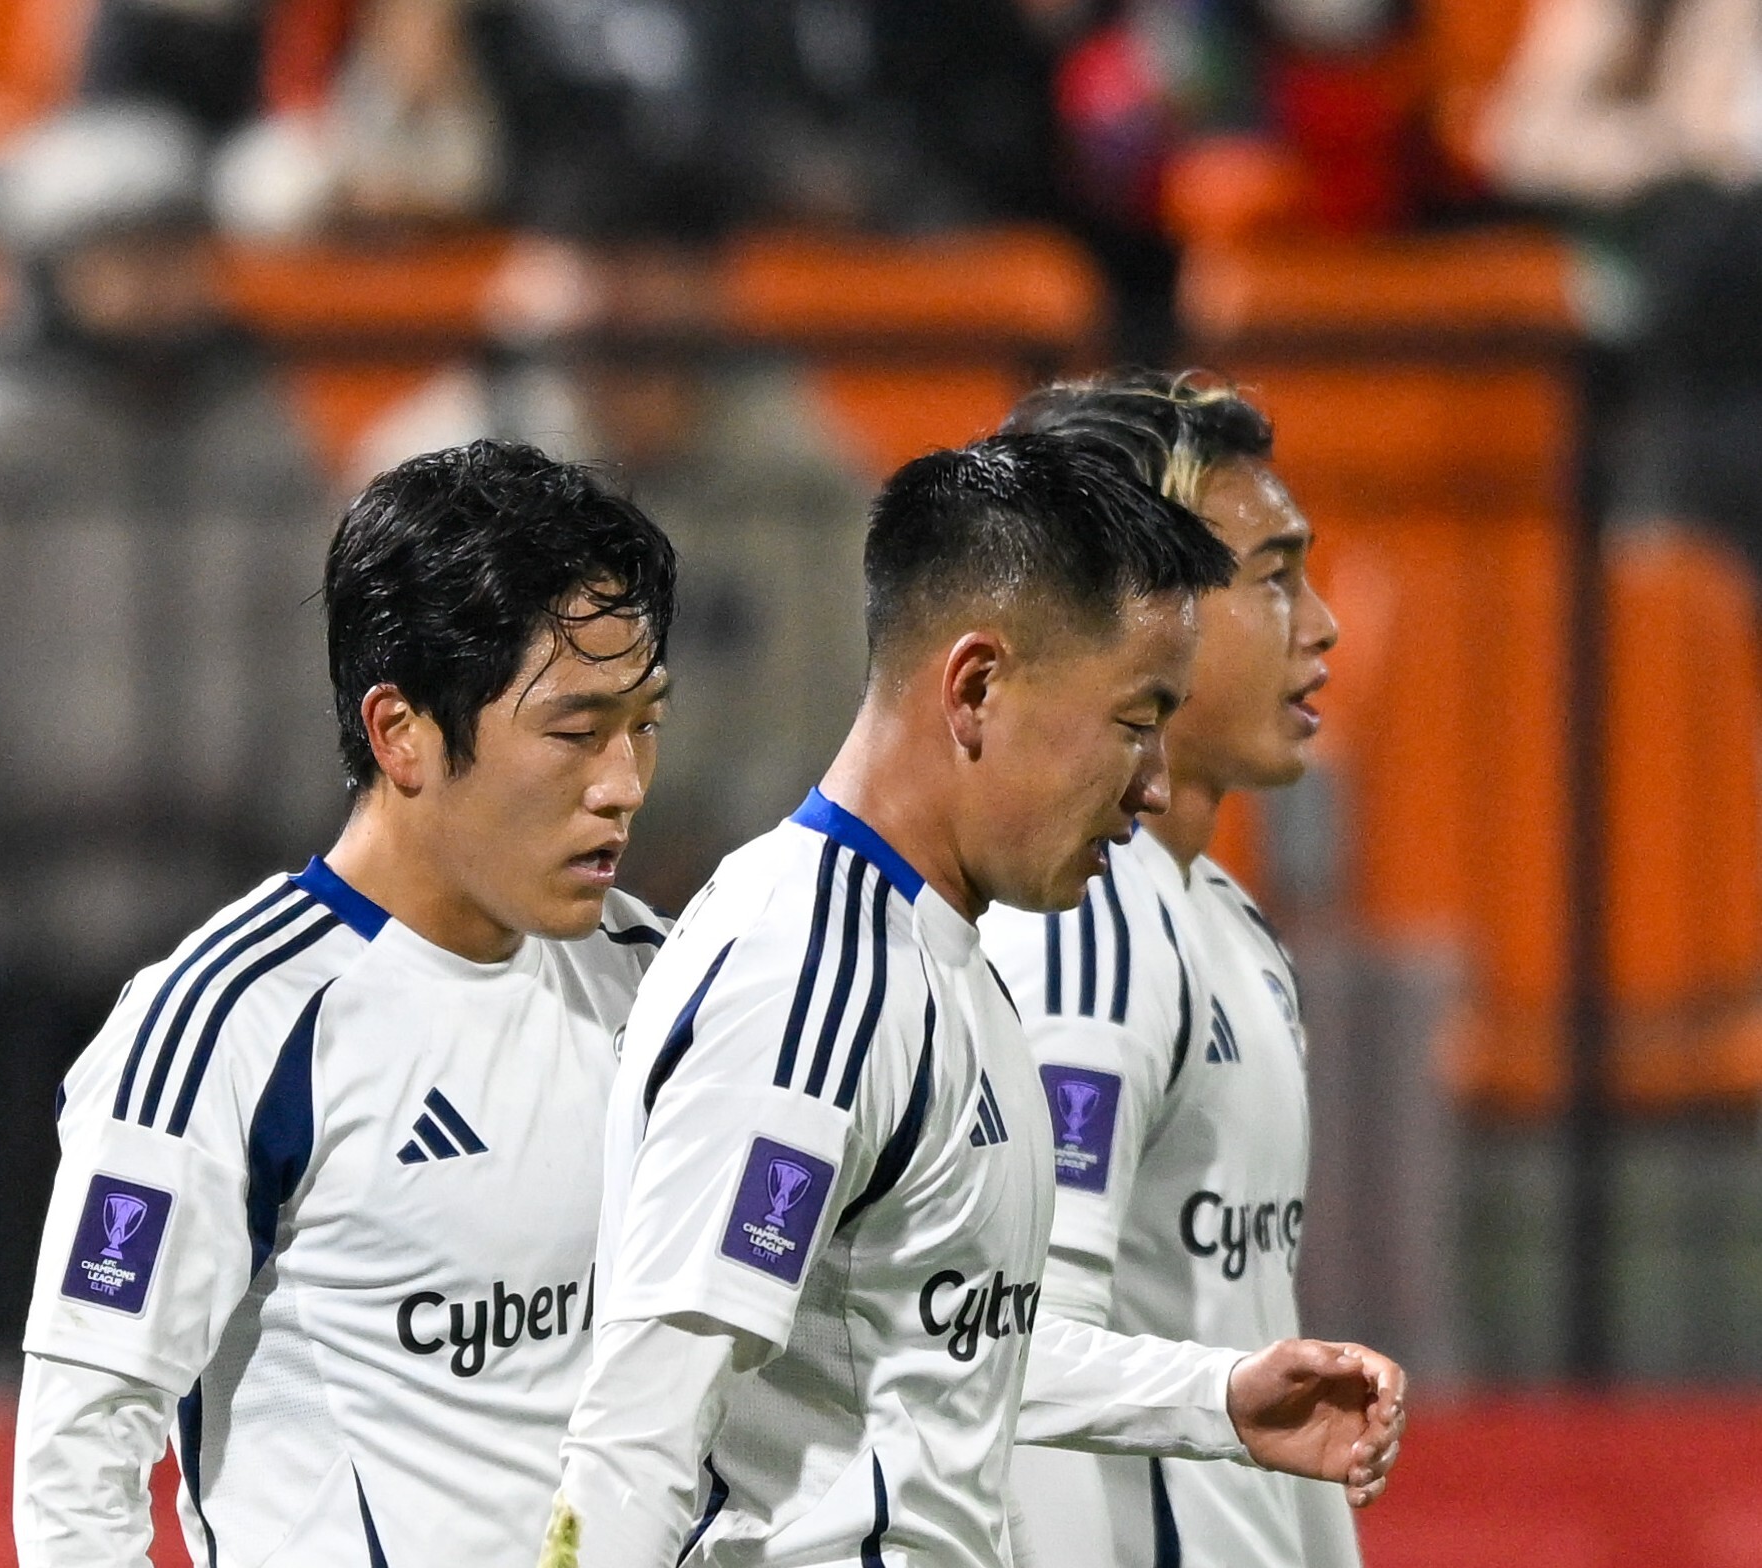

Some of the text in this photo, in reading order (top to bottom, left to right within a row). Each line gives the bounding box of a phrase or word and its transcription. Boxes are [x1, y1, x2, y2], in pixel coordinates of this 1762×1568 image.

[742, 1222, 796, 1251] CHAMPIONS
[750, 1235, 784, 1256] LEAGUE
[81, 1260, 136, 1282] CHAMPIONS
[87, 1270, 123, 1288] LEAGUE
